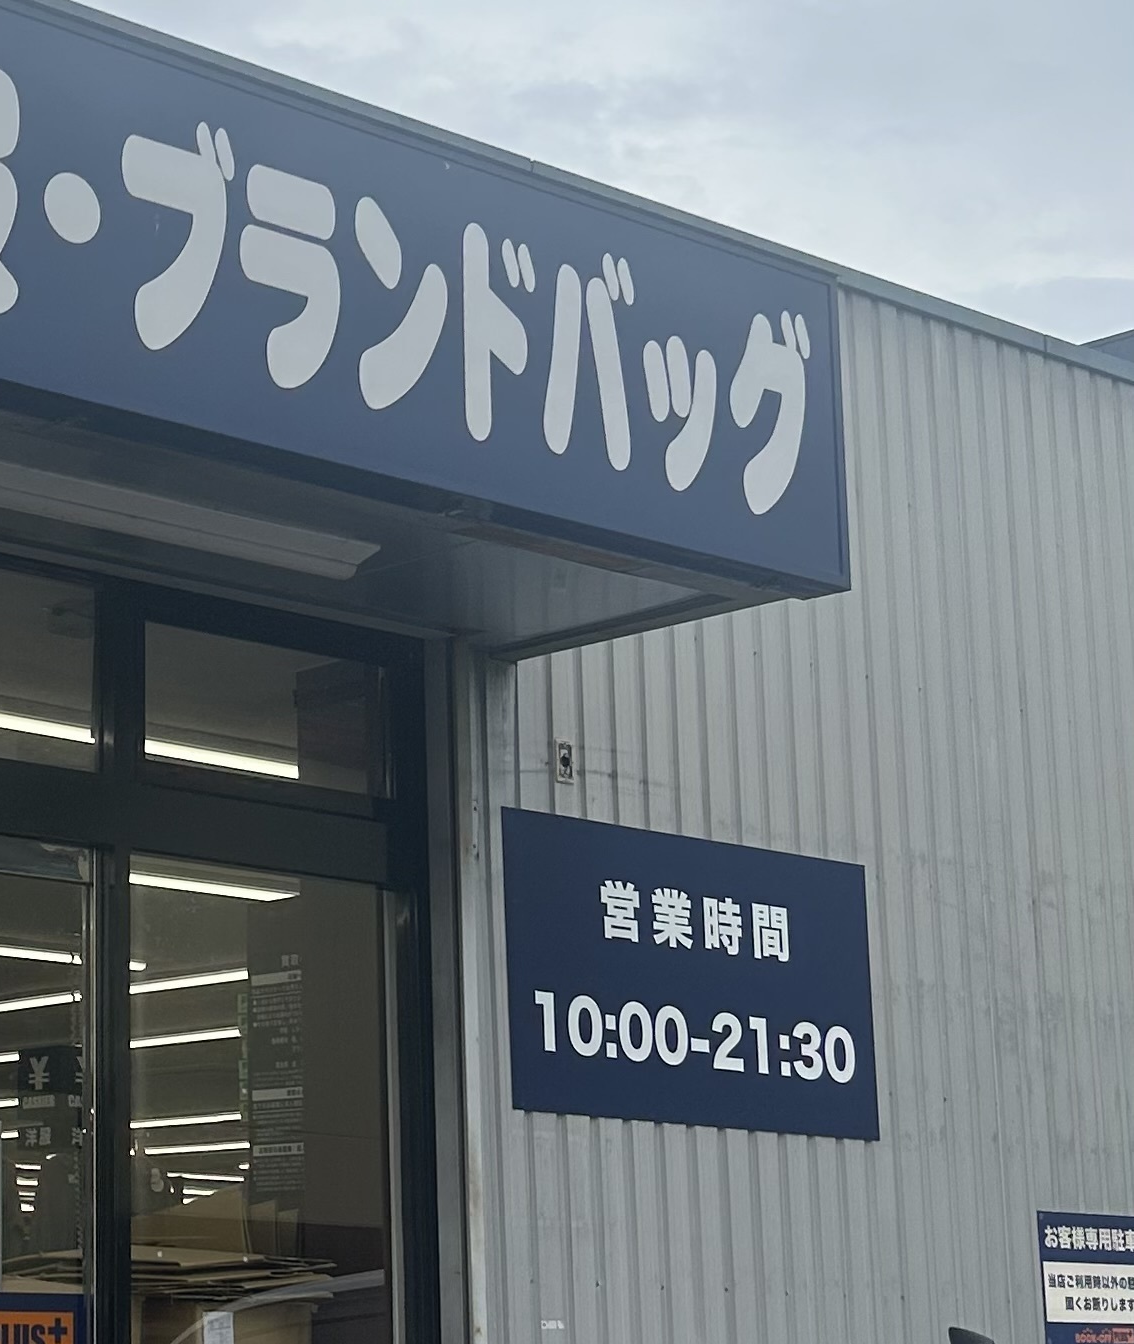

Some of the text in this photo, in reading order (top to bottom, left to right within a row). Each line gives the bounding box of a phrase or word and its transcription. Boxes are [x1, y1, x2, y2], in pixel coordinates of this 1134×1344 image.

[600, 880, 790, 962] 営業時間
[534, 990, 856, 1084] 10:00-21:30
